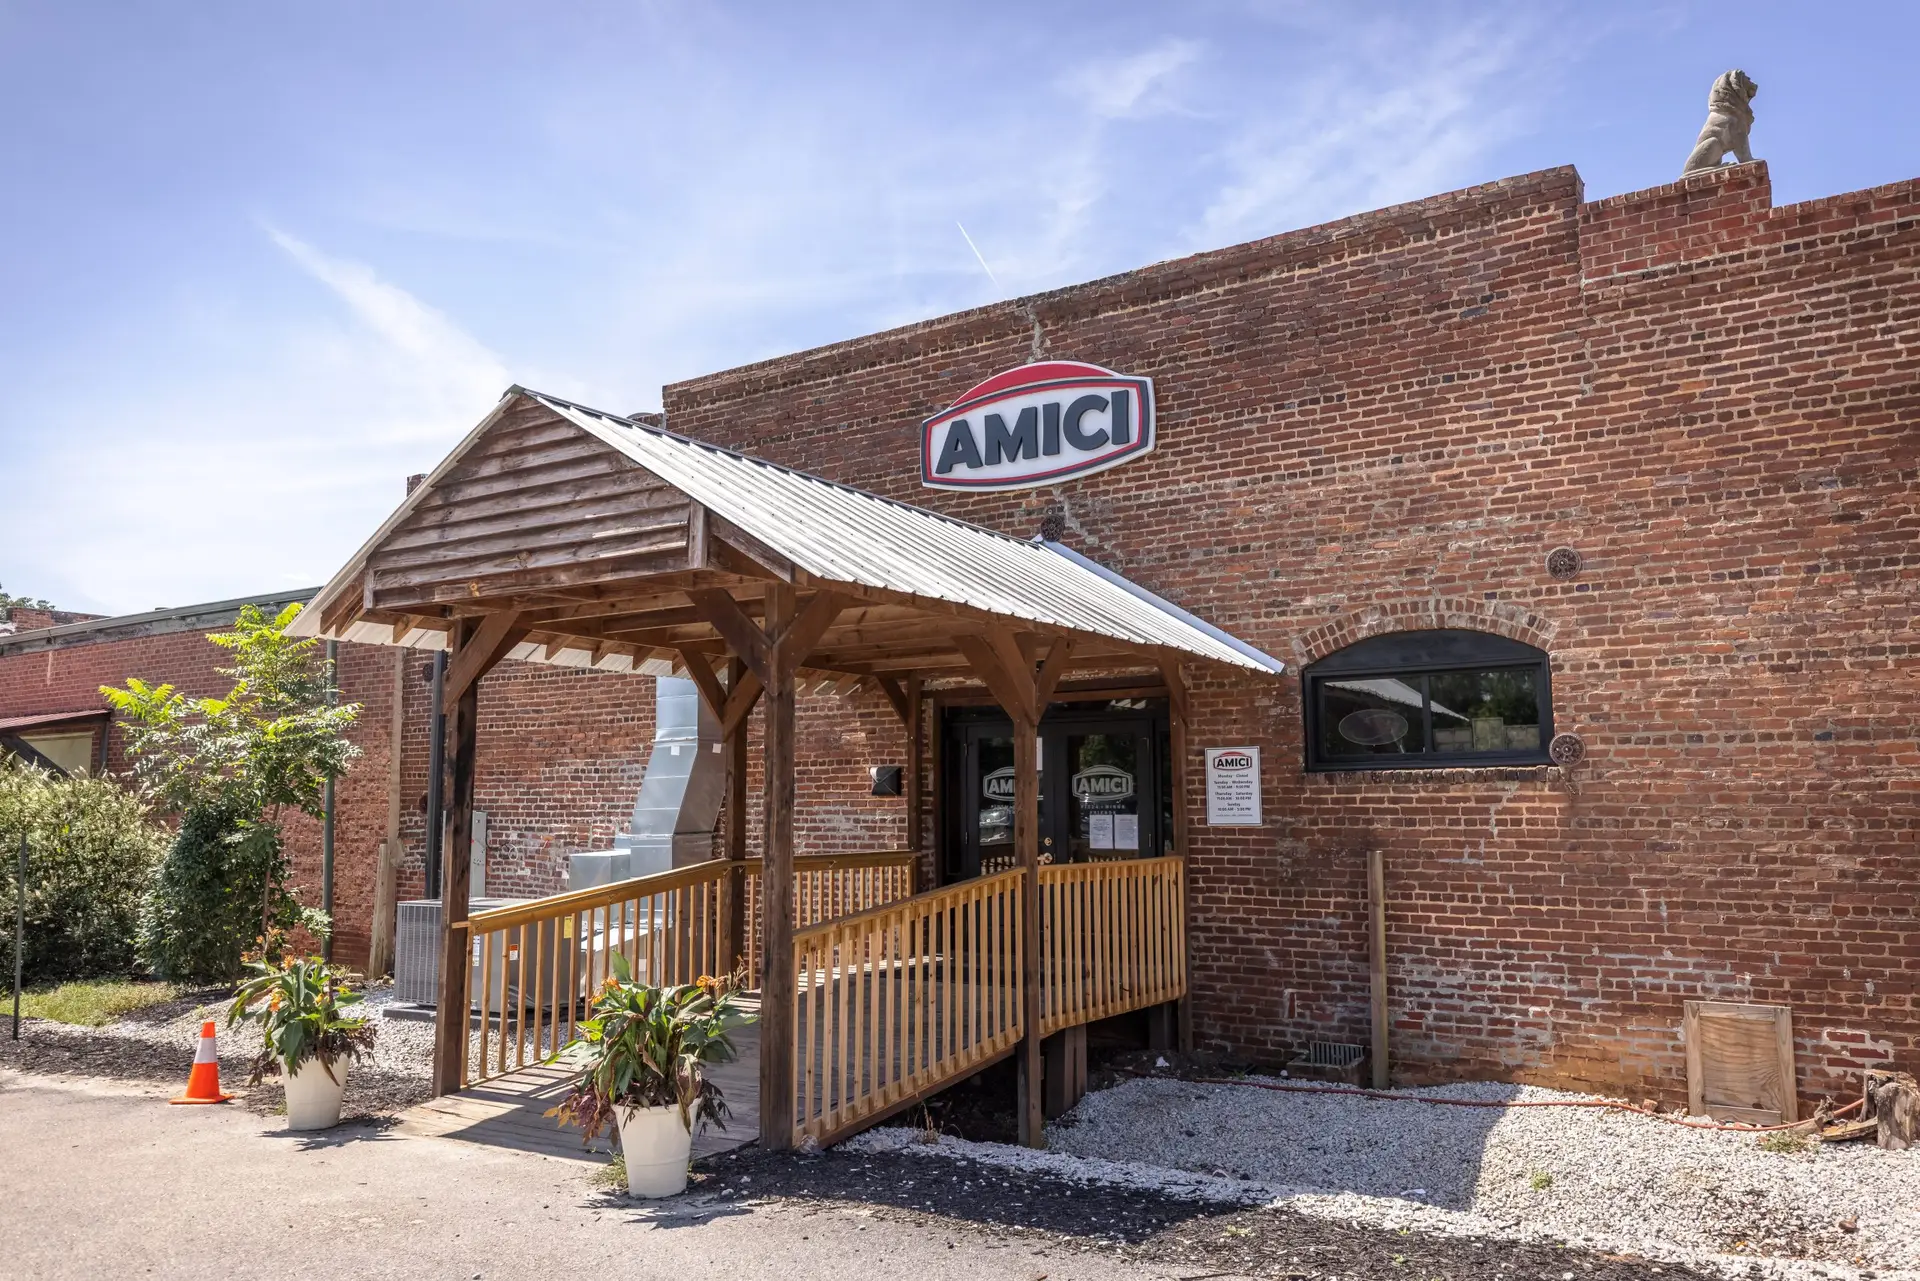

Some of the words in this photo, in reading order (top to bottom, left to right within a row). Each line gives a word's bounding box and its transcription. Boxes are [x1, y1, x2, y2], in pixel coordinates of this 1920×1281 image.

[935, 389, 1130, 474] AMICI
[1217, 758, 1249, 767] AMICI
[1078, 777, 1127, 793] AMICI
